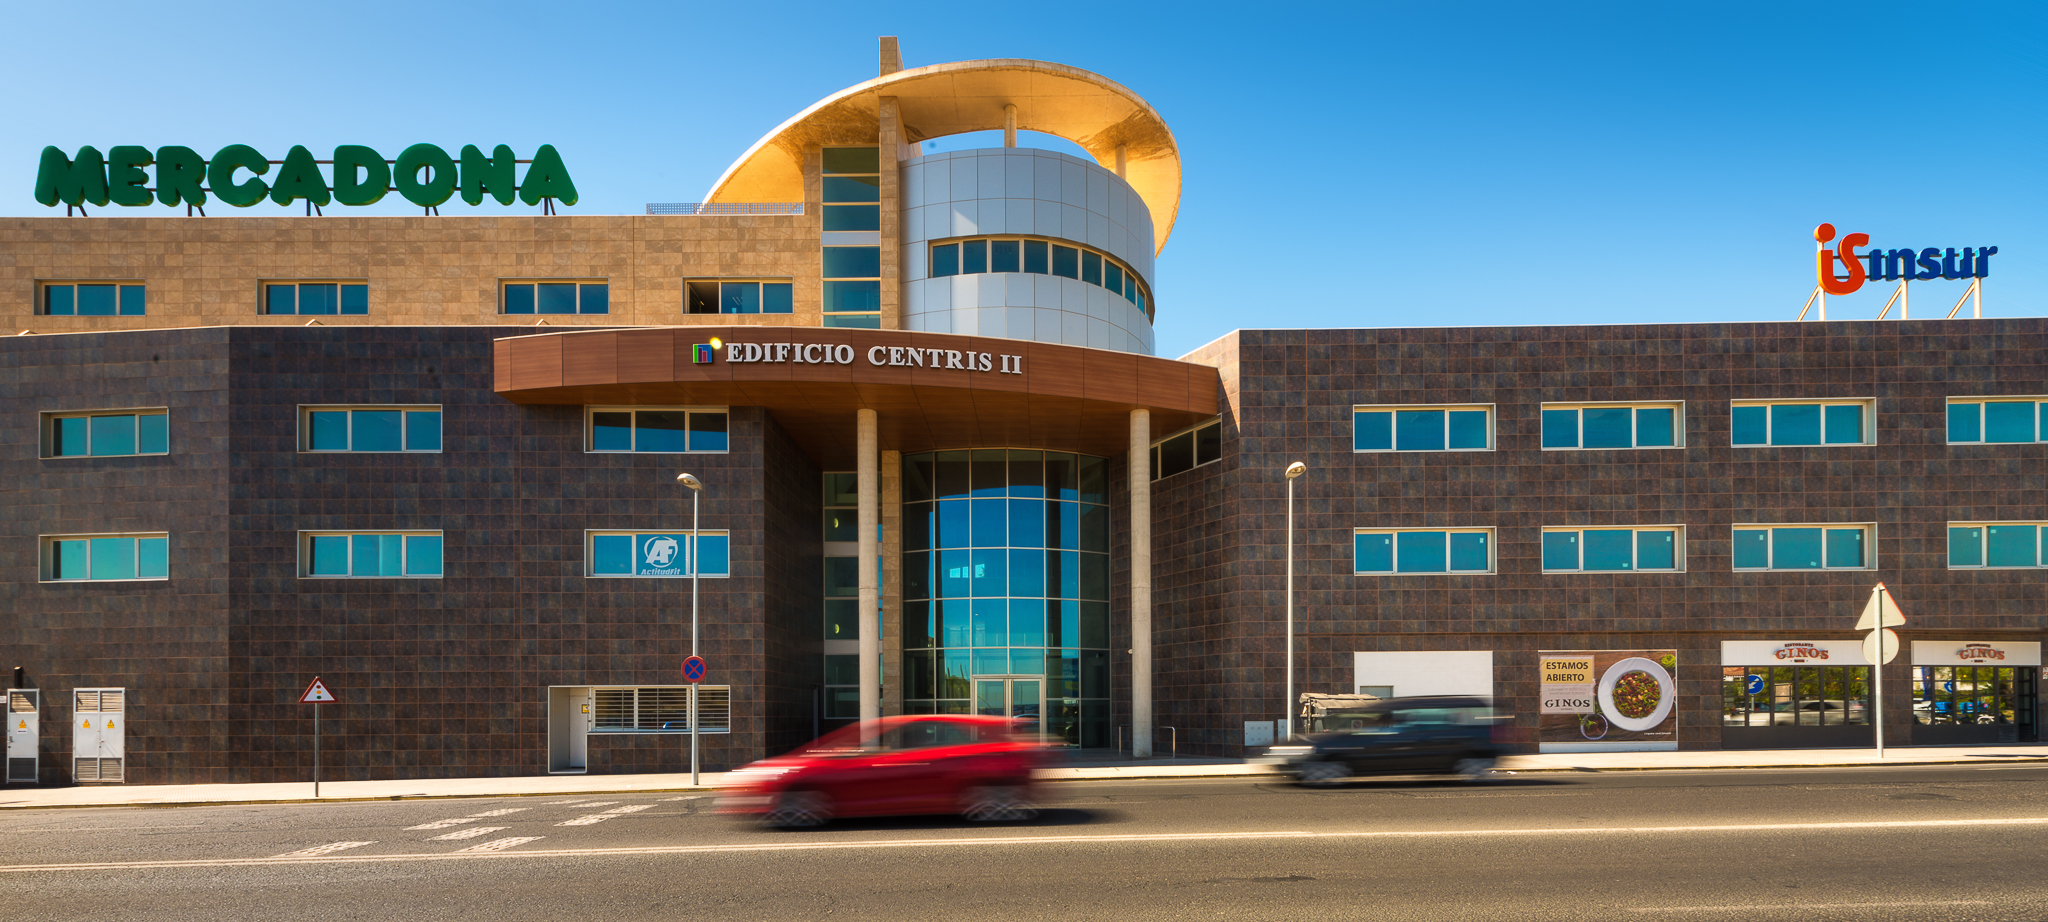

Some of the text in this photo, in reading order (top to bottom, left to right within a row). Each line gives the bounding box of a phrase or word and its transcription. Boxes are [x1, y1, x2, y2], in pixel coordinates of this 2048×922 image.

[34, 143, 579, 207] MERCADONA
[725, 342, 1023, 374] EDIFICIO CENTRIS II
[641, 567, 680, 575] ActitudFit
[1775, 648, 1829, 660] GINOS
[1959, 648, 2005, 660] GINOS
[1546, 661, 1589, 670] ESTAMOS
[1546, 673, 1585, 682] ABIERTO
[1544, 698, 1591, 708] GINOS
